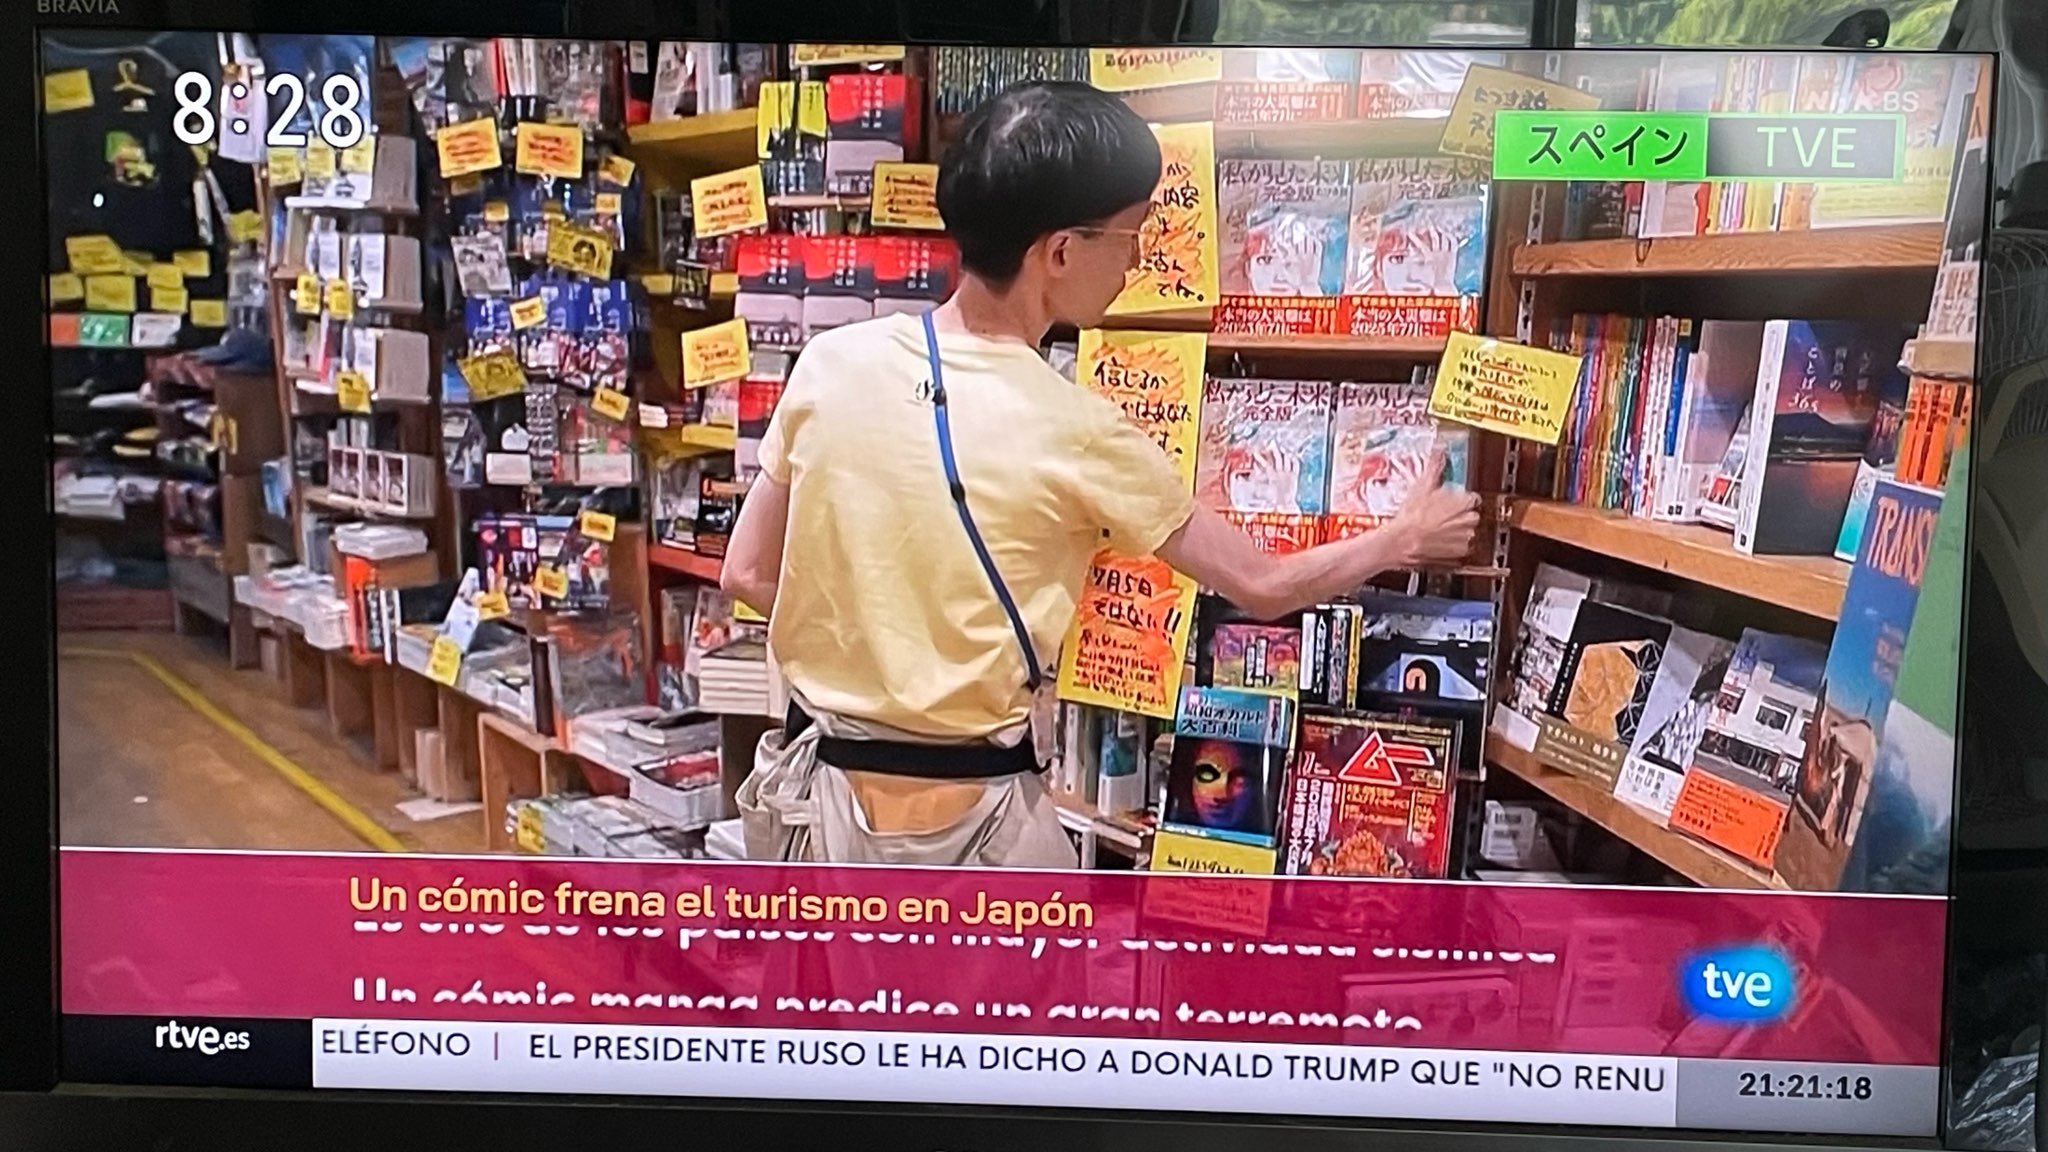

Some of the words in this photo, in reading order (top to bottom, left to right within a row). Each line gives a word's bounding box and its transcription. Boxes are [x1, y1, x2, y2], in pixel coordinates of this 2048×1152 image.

[37, 0, 120, 14] BRAVIA
[173, 71, 365, 149] 8:28
[1883, 91, 1920, 113] BS
[1528, 124, 1689, 167] スペイン
[1756, 126, 1857, 169] TVE
[1093, 355, 1169, 391] 信じるか
[351, 876, 408, 912] Un
[418, 876, 546, 914] cómic
[554, 881, 665, 917] frena
[676, 884, 717, 919] el
[725, 885, 888, 922] turismo
[898, 896, 949, 923] en
[959, 890, 1094, 935] Japón
[1702, 962, 1773, 1007] tve
[155, 1020, 251, 1056] rtve.es
[321, 1024, 471, 1057] ELÉFONO
[529, 1034, 562, 1059] EL
[573, 1034, 767, 1064] PRESIDENTE
[778, 1040, 866, 1067] RUSO
[878, 1043, 910, 1068] LE
[921, 1044, 967, 1069] HA
[979, 1046, 1087, 1073] DICHO
[1097, 1049, 1120, 1074] A
[1131, 1051, 1273, 1079] DONALD
[1283, 1055, 1400, 1083] TRUMP
[1410, 1060, 1481, 1087] QUE
[1491, 1061, 1563, 1090] "NO
[1573, 1064, 1667, 1094] RENU
[1738, 1072, 1873, 1101] 21:21:18
